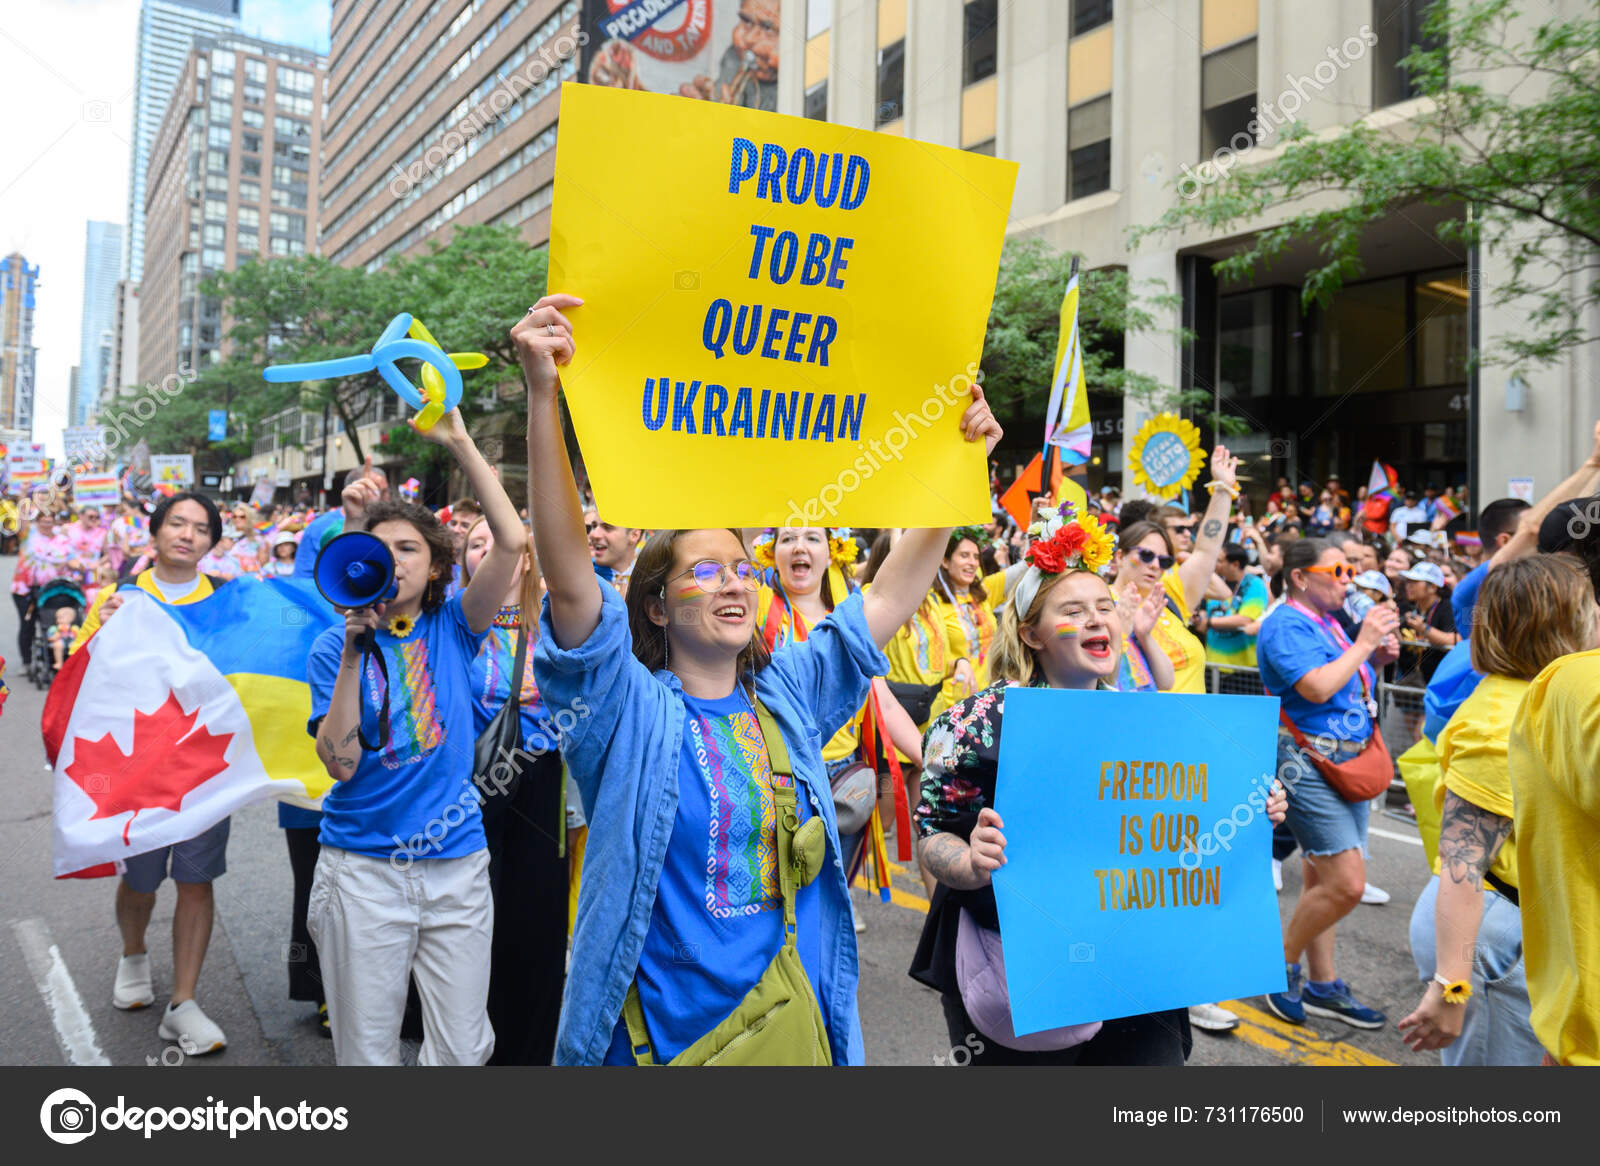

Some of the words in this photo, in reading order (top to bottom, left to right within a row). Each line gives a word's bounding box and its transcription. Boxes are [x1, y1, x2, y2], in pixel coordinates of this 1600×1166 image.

[729, 138, 870, 210] PROUD
[749, 225, 798, 285] TO
[800, 233, 854, 289] BE
[703, 299, 837, 366] QUEER
[642, 378, 867, 442] UKRAINIAN
[1099, 760, 1208, 802] FREEDOM
[1120, 815, 1143, 856] IS
[1149, 812, 1200, 855] OUR
[1094, 866, 1221, 911] TRADITION
